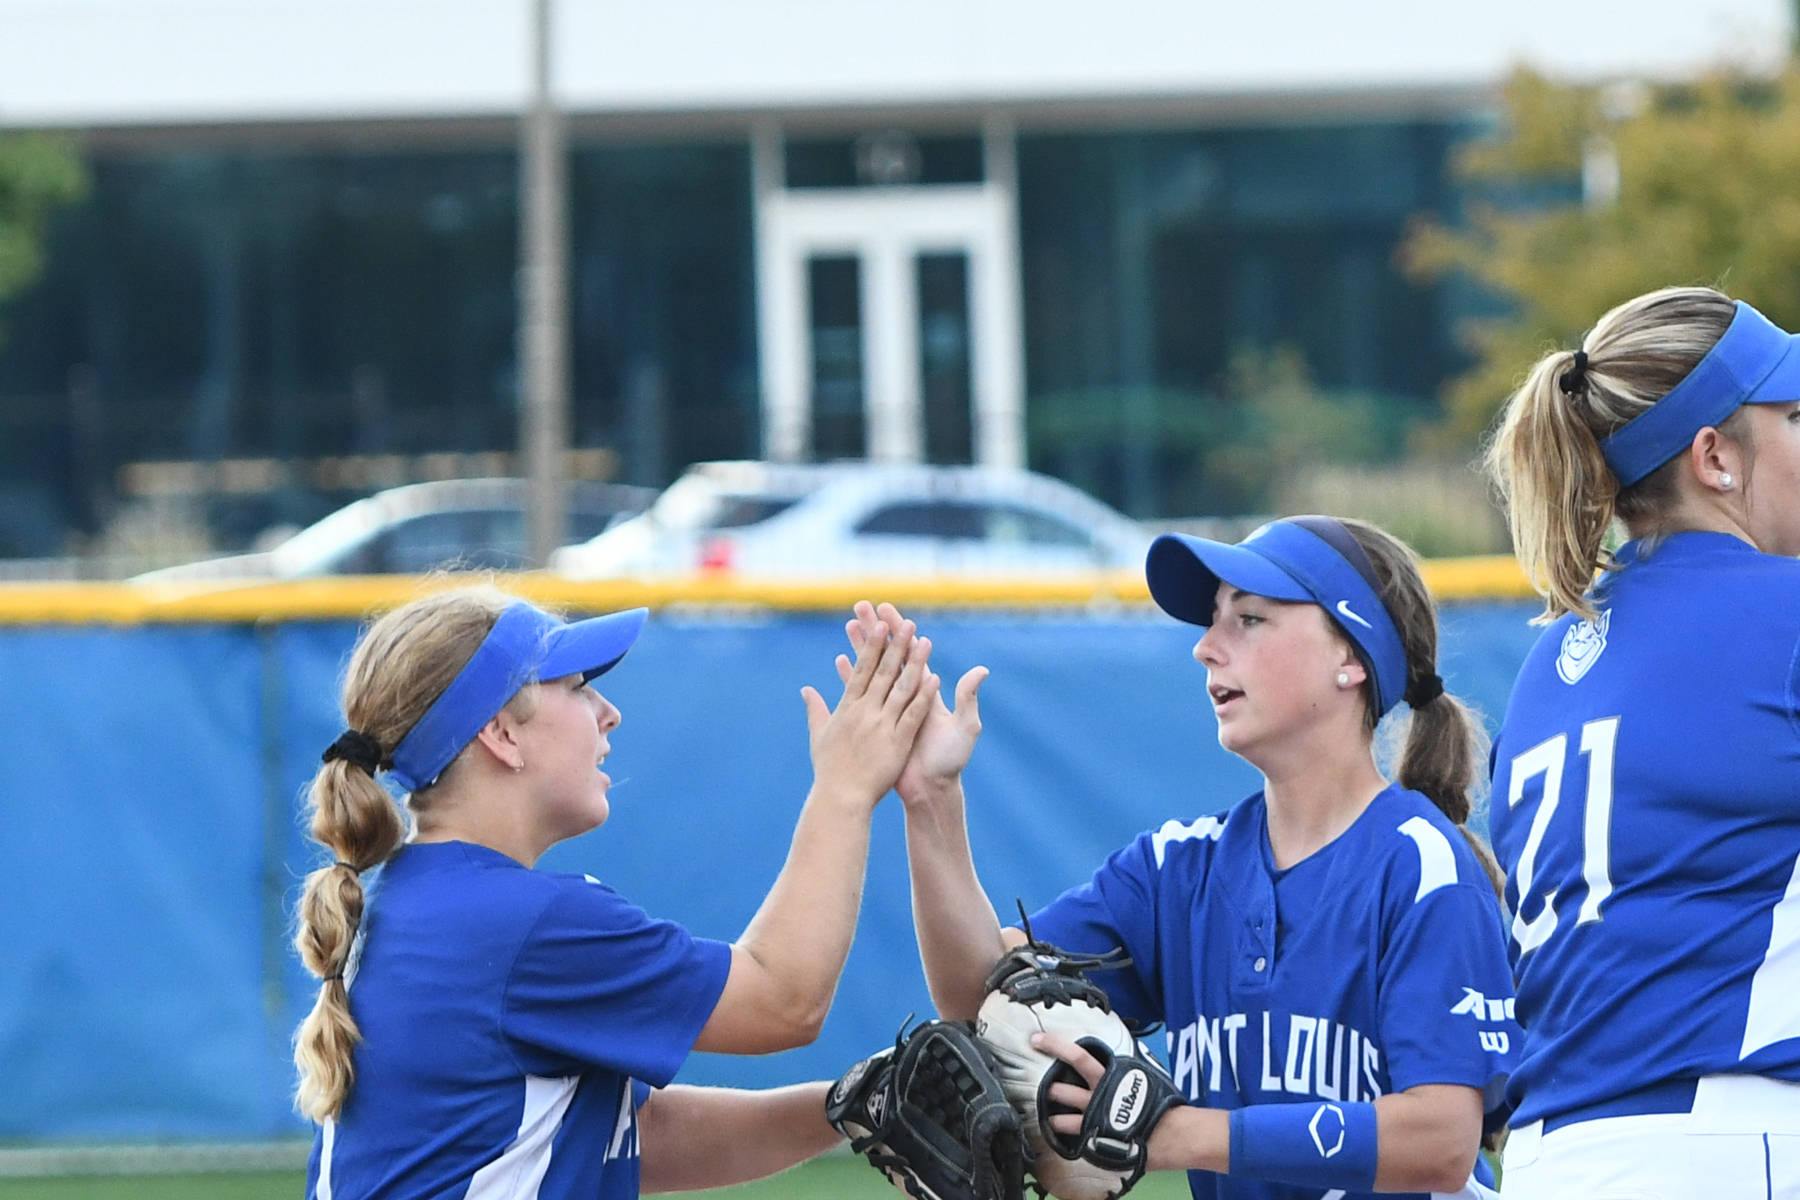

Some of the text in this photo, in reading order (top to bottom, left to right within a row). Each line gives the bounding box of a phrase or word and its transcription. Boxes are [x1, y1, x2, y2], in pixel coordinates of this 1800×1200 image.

[1508, 715, 1622, 957] 21
[1115, 1073, 1144, 1124] Wilson
[1261, 1010, 1383, 1104] LOUIS
